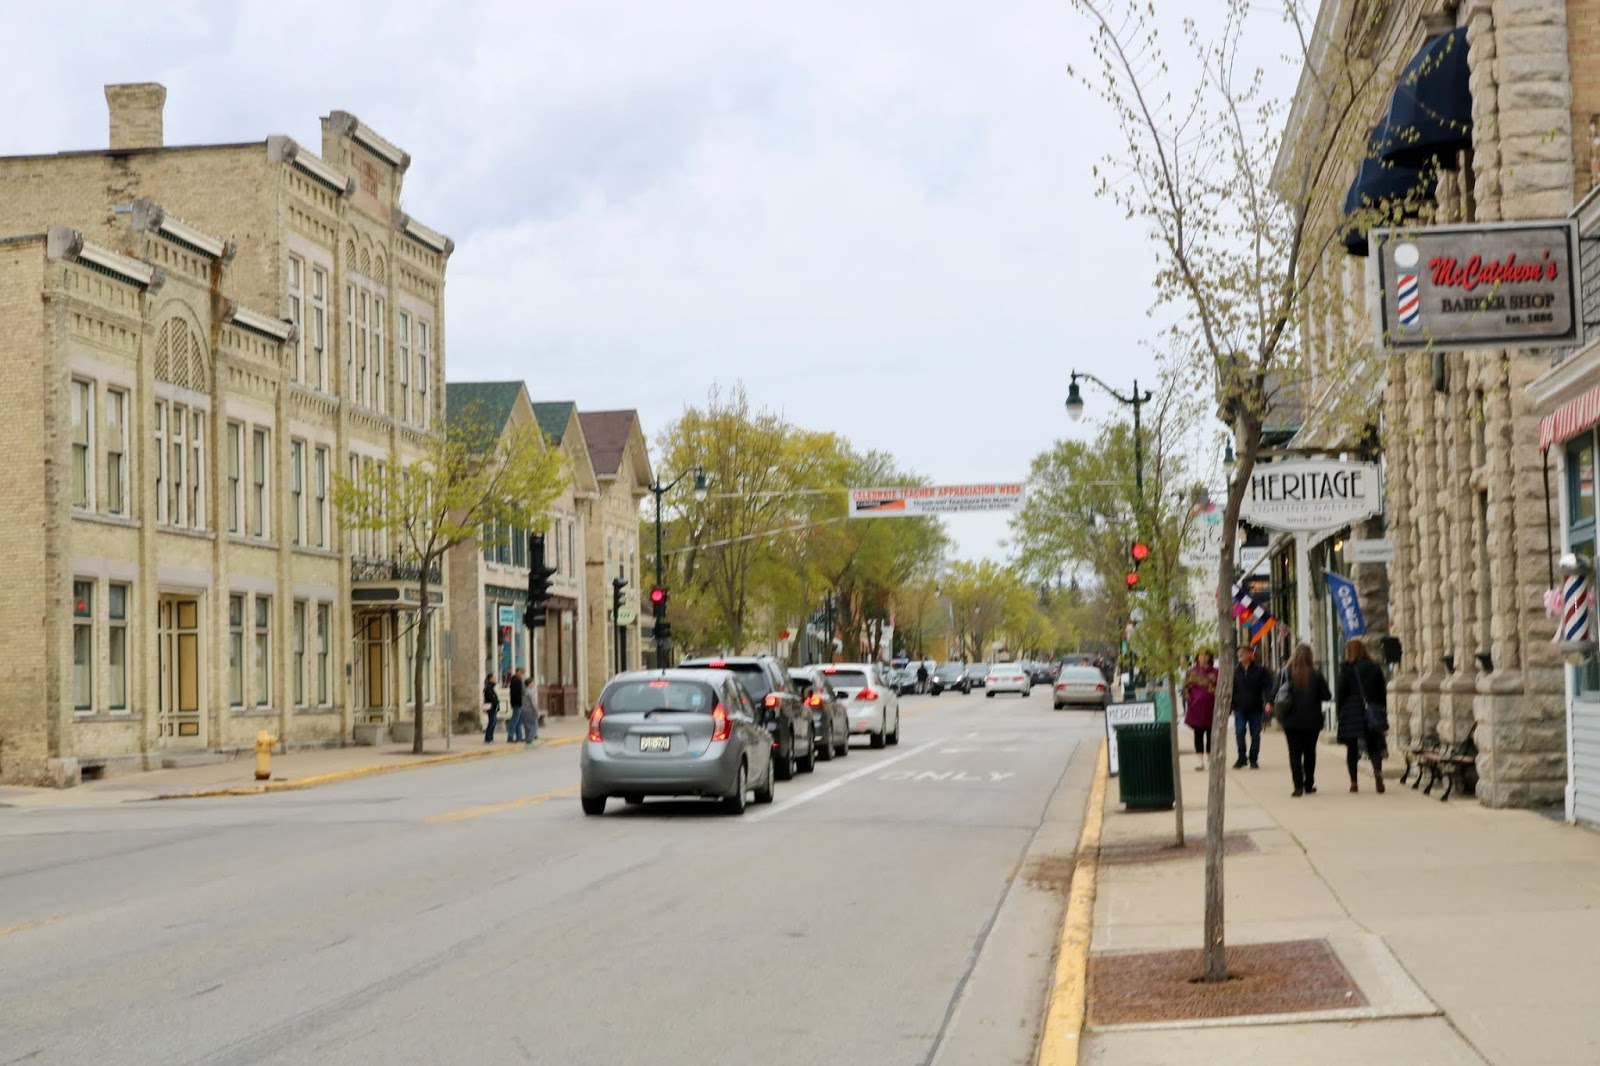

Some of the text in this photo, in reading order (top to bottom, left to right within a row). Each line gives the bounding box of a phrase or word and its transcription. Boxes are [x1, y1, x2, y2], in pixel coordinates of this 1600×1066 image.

[1428, 250, 1557, 291] McCutcheon's
[1510, 293, 1555, 310] SHOP
[1252, 471, 1365, 501] HERITAGE
